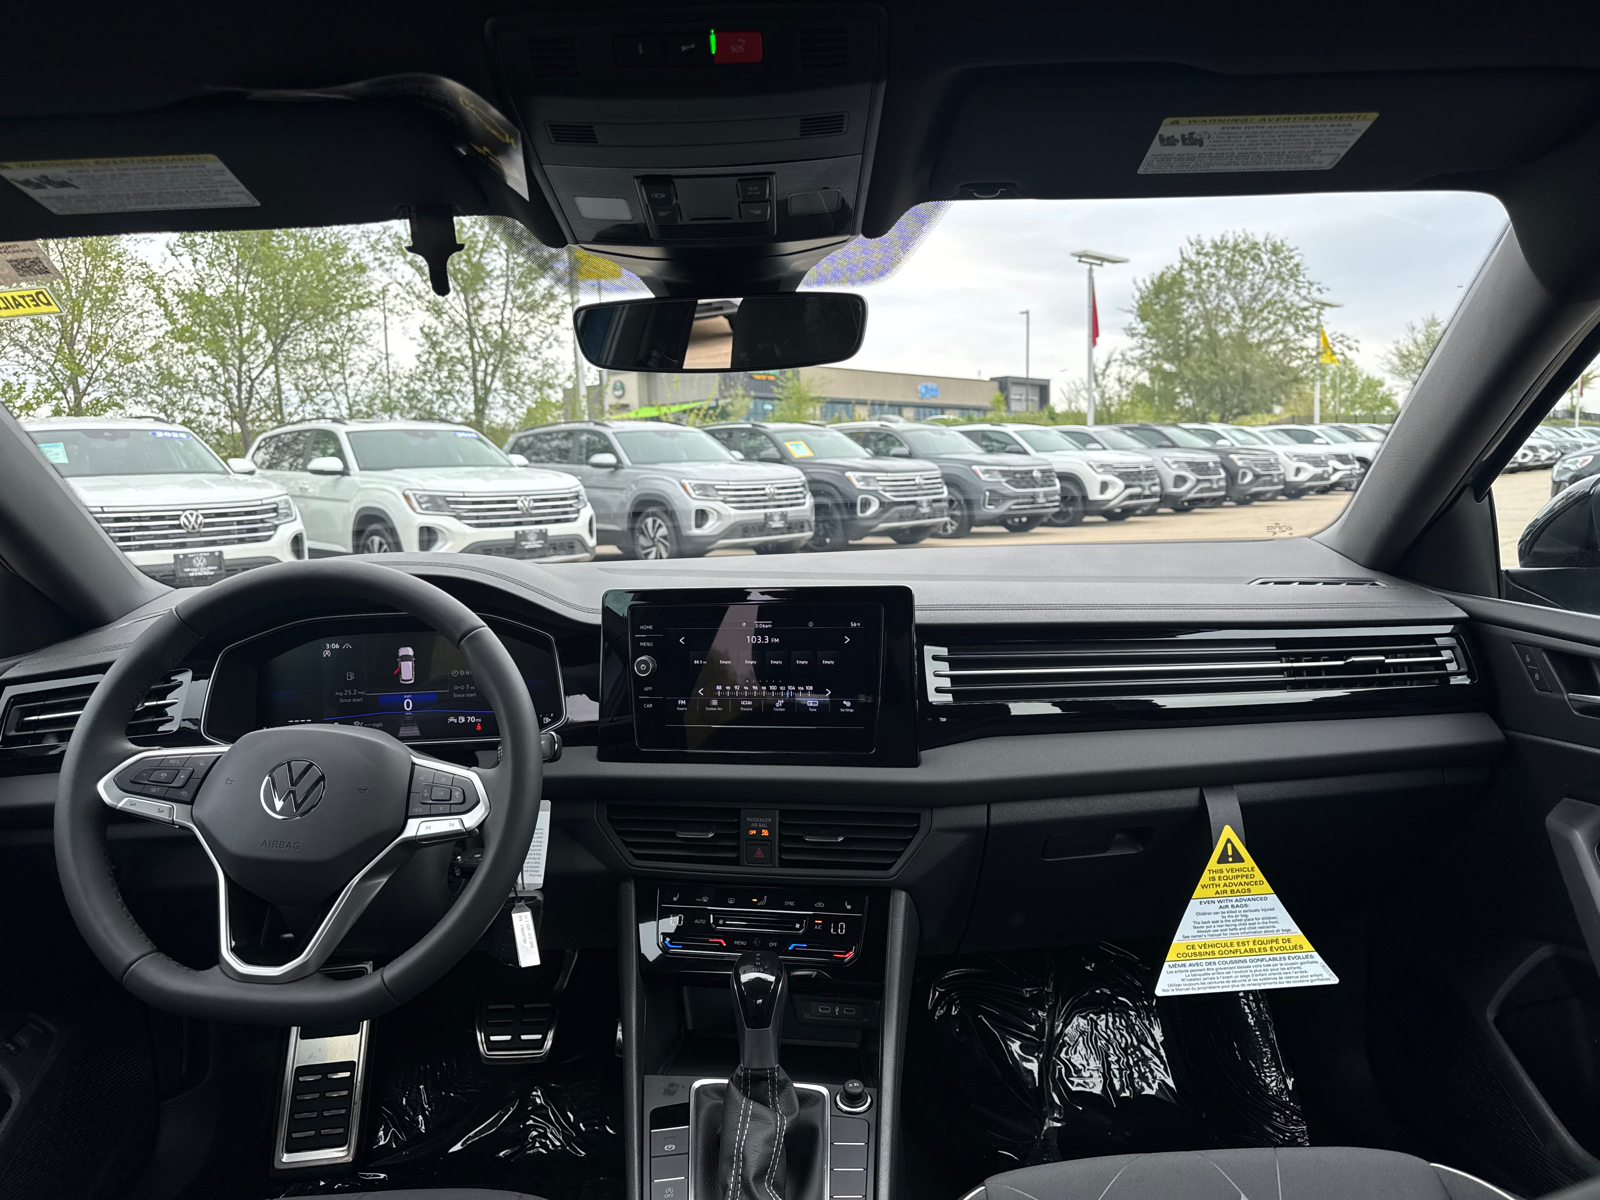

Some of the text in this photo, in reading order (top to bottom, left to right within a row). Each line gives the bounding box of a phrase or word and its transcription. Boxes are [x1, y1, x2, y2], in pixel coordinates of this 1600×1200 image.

[731, 45, 745, 53] SOS
[404, 699, 412, 710] 0
[260, 839, 300, 851] AIRBAG
[831, 922, 846, 935] LO
[1198, 942, 1234, 950] VÉHICULE
[1252, 937, 1280, 946] ÉQUIPÉ
[1218, 947, 1268, 956] GONFLABLES
